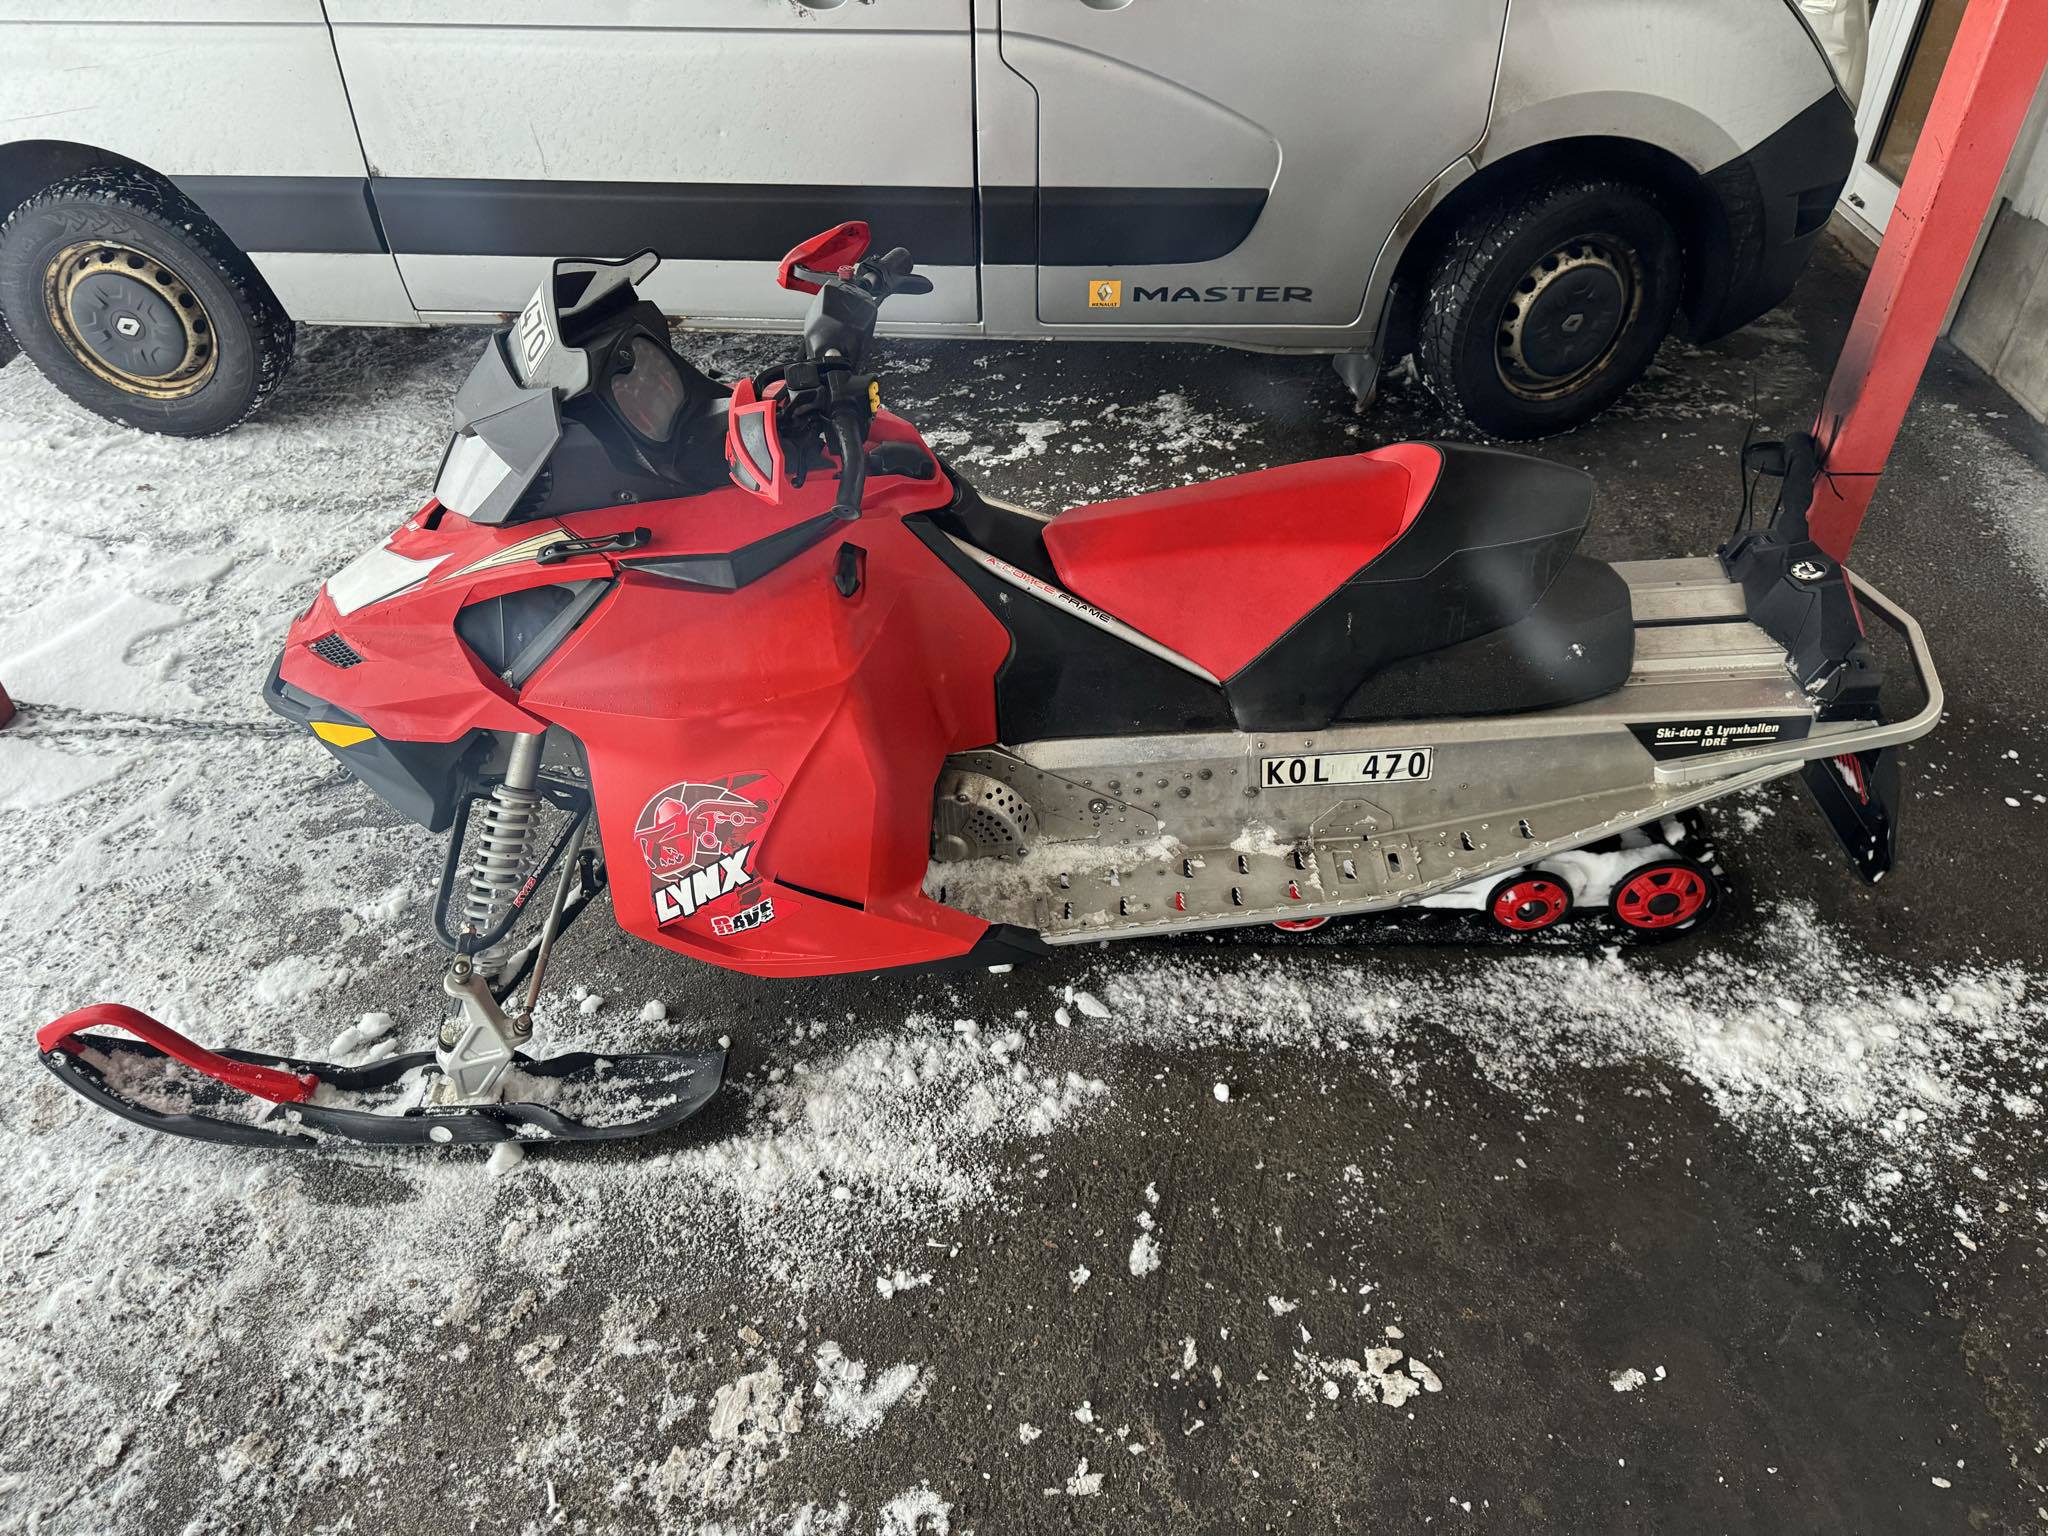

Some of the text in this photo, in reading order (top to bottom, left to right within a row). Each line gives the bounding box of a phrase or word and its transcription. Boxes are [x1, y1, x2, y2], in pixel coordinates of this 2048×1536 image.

[1133, 286, 1313, 303] MASTER
[521, 300, 546, 362] 470
[1058, 592, 1111, 623] FRAME
[1656, 723, 1780, 739] Ski-doo & Lynxhallen
[1701, 737, 1729, 747] IDRE
[1266, 752, 1426, 785] KOL 470
[654, 843, 753, 924] LYNX
[710, 896, 776, 936] RAVE
